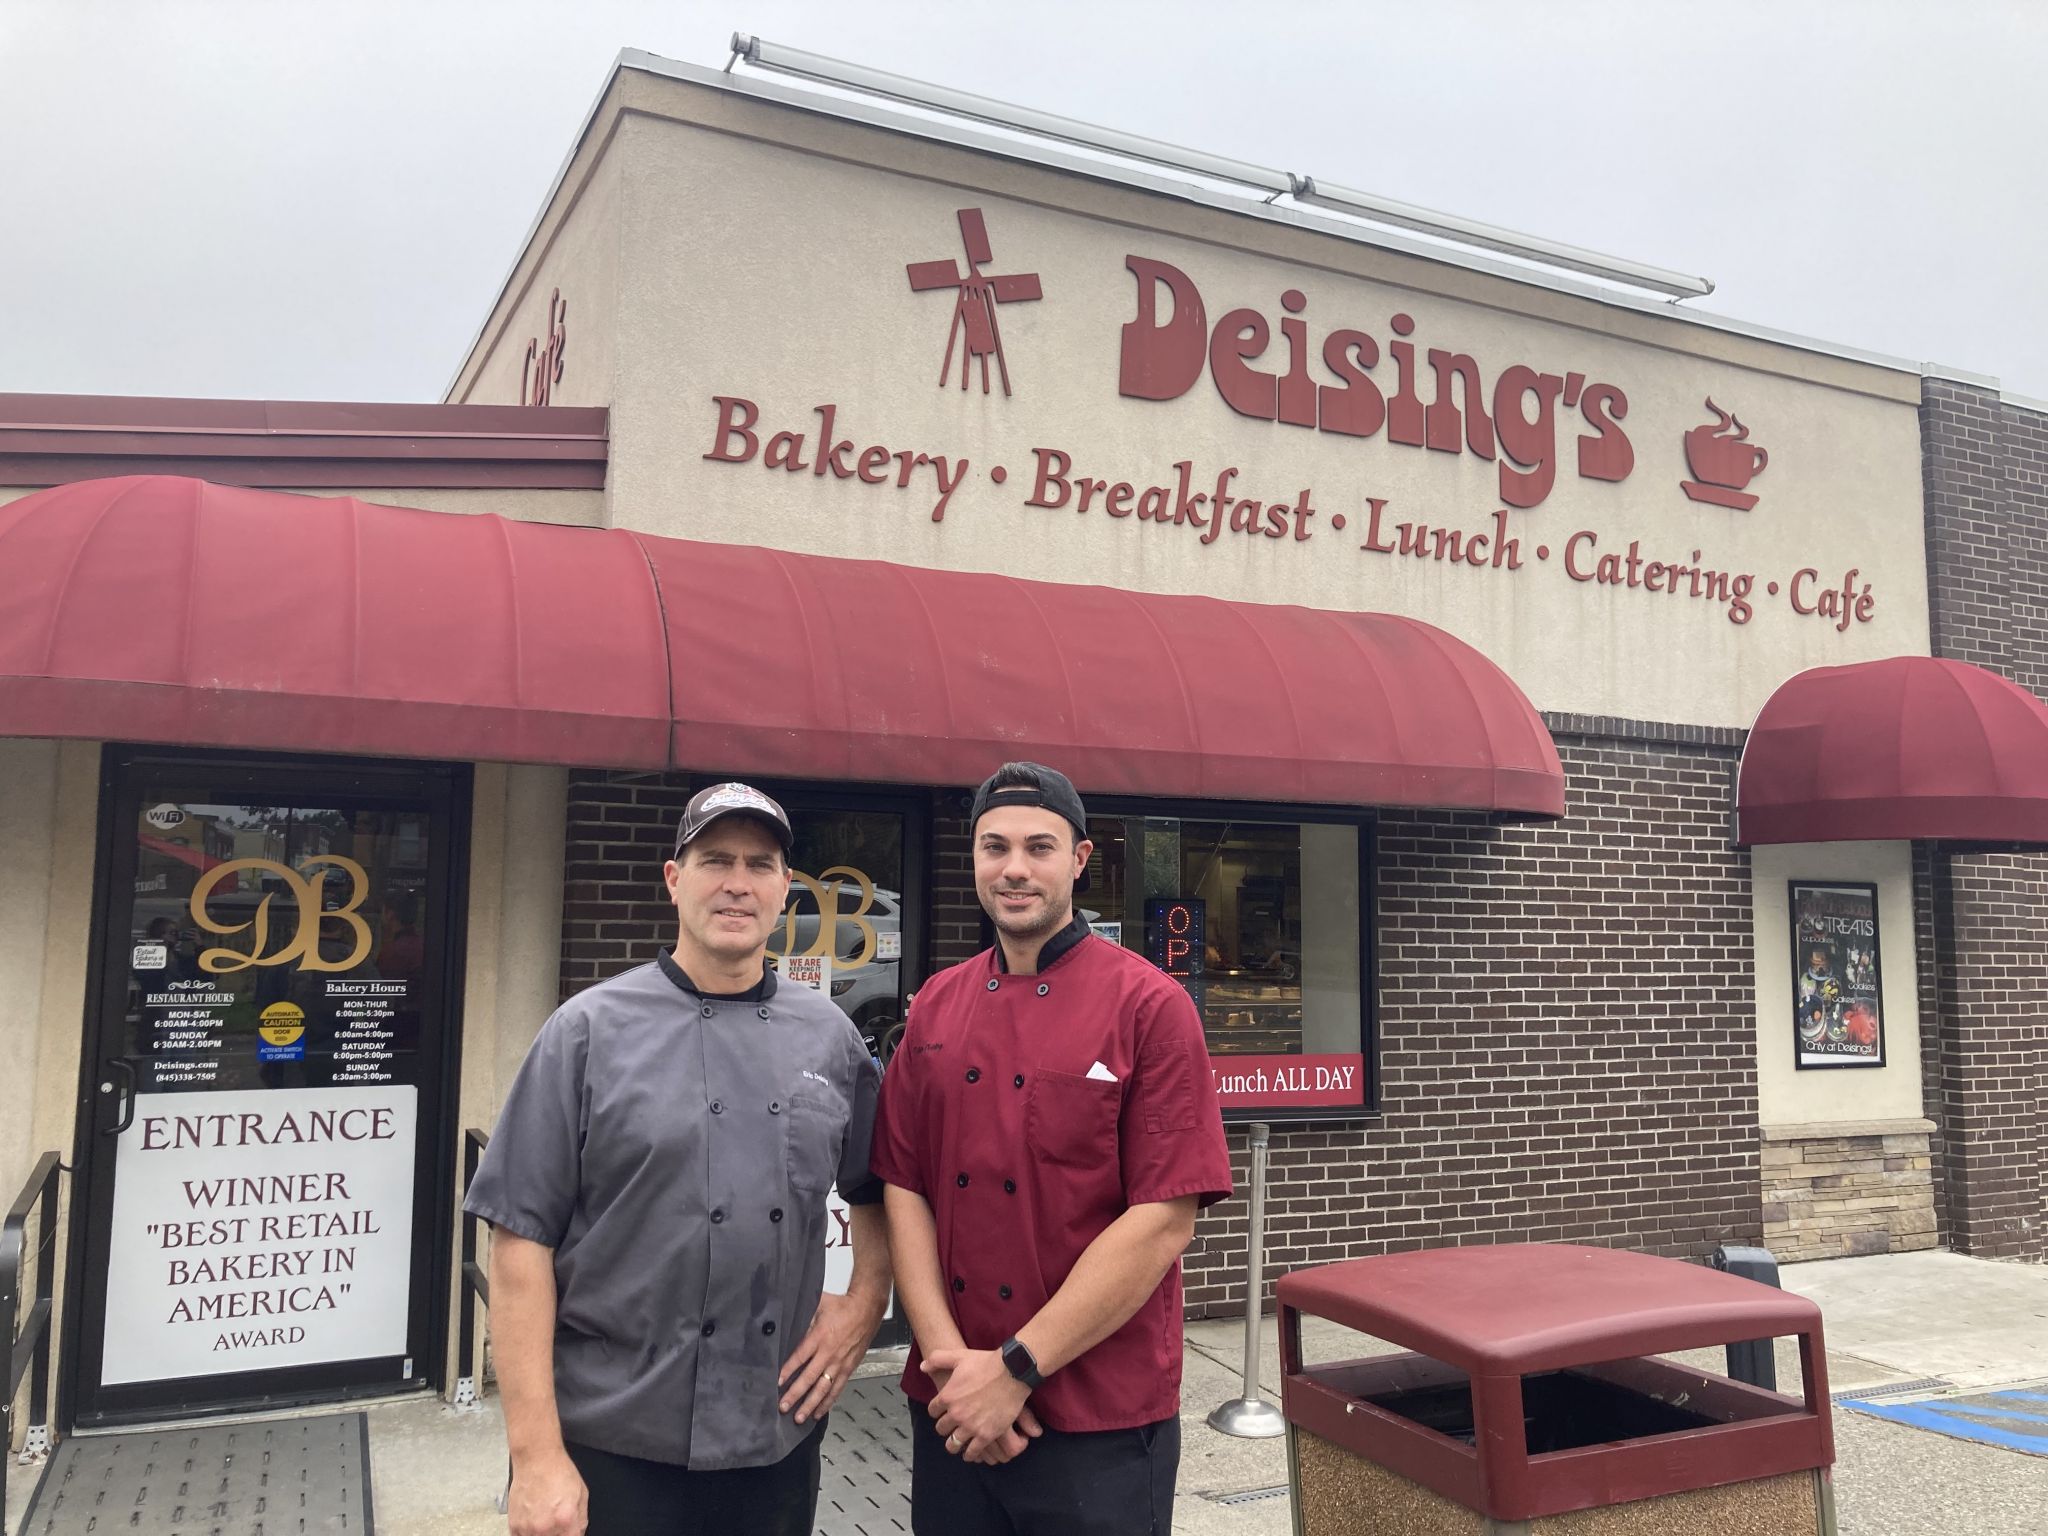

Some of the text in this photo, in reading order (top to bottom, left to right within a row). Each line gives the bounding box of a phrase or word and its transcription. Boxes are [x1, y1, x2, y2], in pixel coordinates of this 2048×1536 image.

[1119, 253, 1635, 508] Deising's
[702, 395, 1875, 632] Bakery Breakfast Lunch Catering Café
[1823, 916, 1874, 937] TREATS
[789, 958, 821, 966] WE ARE
[789, 972, 821, 981] CLEAN
[326, 983, 407, 994] Bakery Hours
[146, 992, 235, 1003] RESTAURANT HOURS
[168, 1010, 212, 1019] MON-SAT
[349, 1021, 380, 1029] FRIDAY
[169, 1031, 208, 1040] SUNDAY
[341, 1042, 386, 1050] SATURDAY
[1805, 1041, 1826, 1052] Only
[1826, 1042, 1836, 1052] at
[153, 1061, 219, 1070] Deisings.com
[346, 1063, 380, 1071] SUNDAY
[1273, 1067, 1311, 1092] ALL
[1315, 1066, 1355, 1091] DAY
[140, 1107, 396, 1151] ENTRANCE
[182, 1172, 352, 1210] WINNER
[146, 1210, 381, 1249] "BEST RETAIL
[166, 1247, 357, 1287] BAKERY IN
[166, 1283, 352, 1324] AMERICA"
[212, 1326, 306, 1352] AWARD
